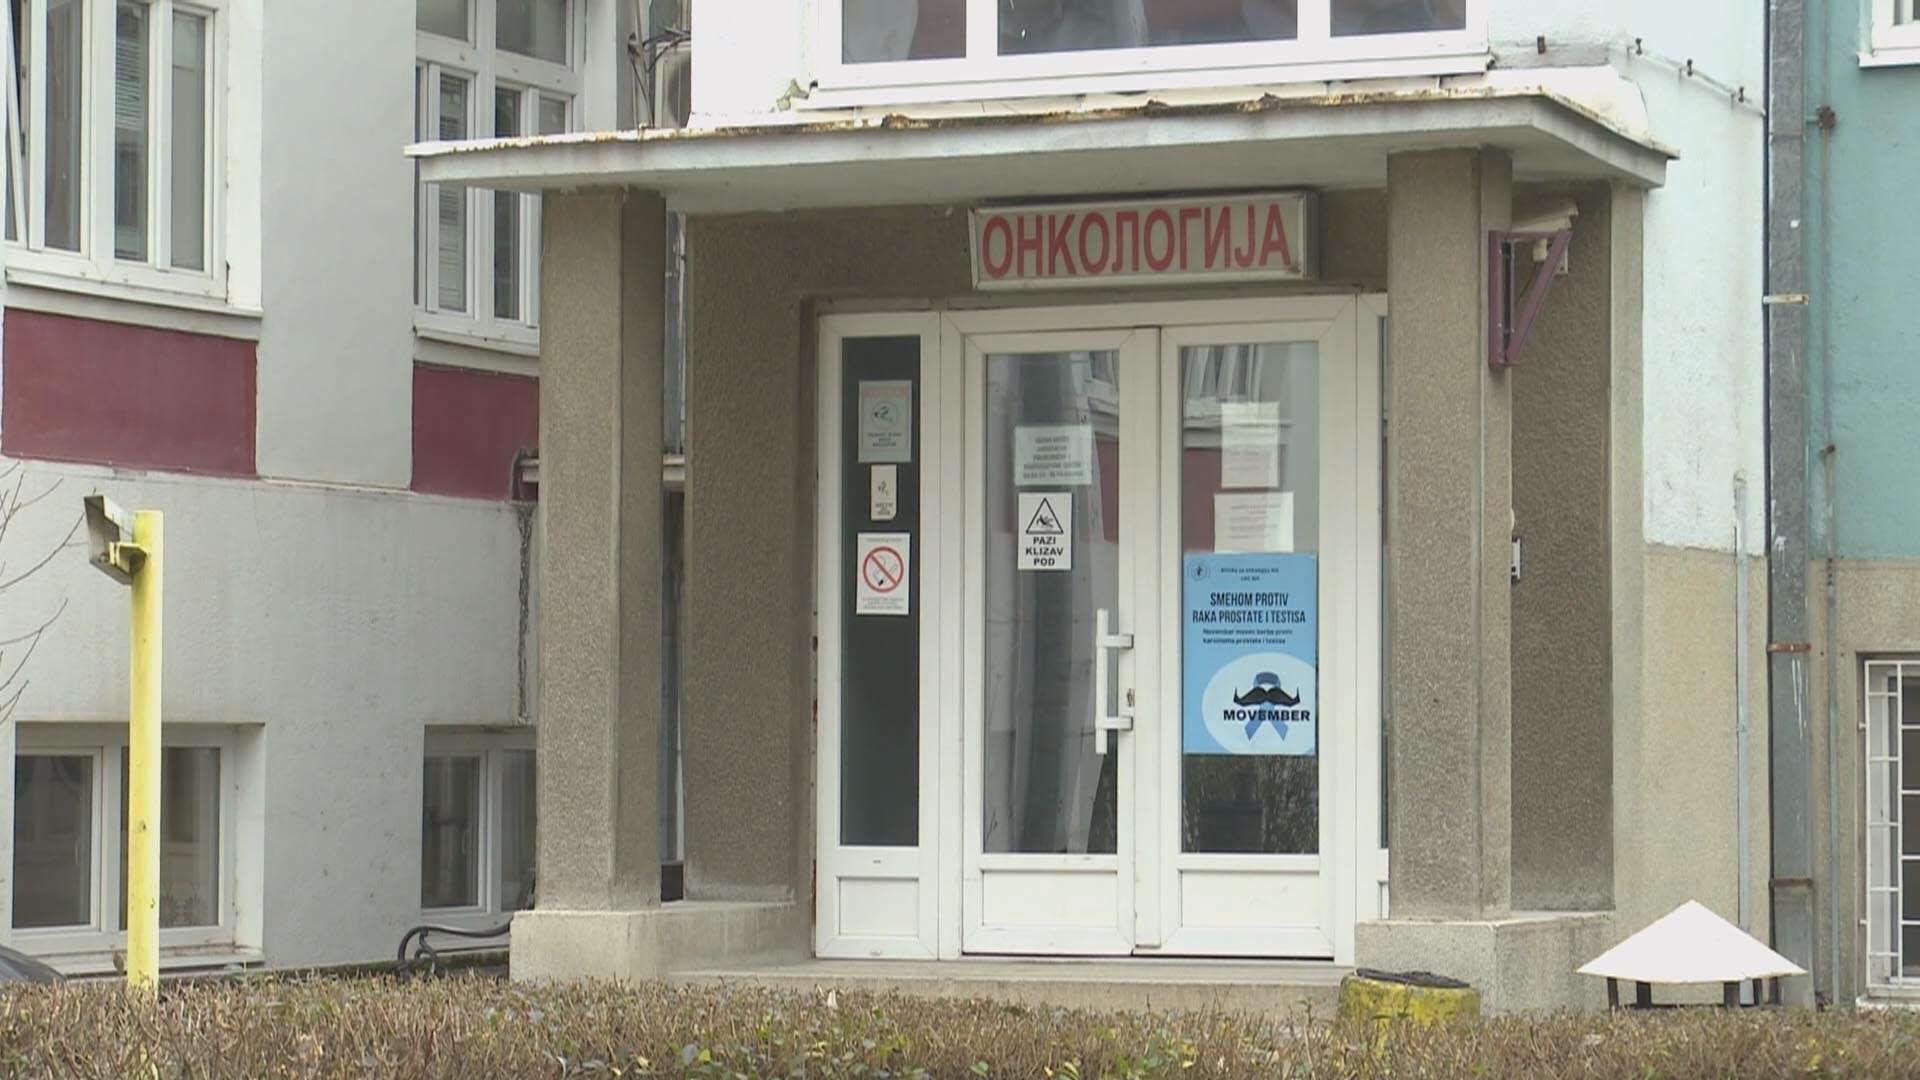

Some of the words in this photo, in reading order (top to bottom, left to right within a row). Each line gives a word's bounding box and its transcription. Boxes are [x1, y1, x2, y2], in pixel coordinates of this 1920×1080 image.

[982, 203, 1291, 279] ОНКОЛОГИЈА
[1033, 536, 1056, 545] PAZI
[1026, 547, 1064, 556] KLIZAV
[1034, 557, 1056, 567] POD
[1210, 592, 1253, 606] SMEHOM
[1255, 592, 1289, 606] PROTIV
[1192, 610, 1217, 624] RAKA
[1219, 610, 1264, 624] PROSTATE
[1265, 610, 1270, 624] I
[1271, 610, 1306, 624] TESTISA
[1223, 709, 1311, 721] MOVEMBER
